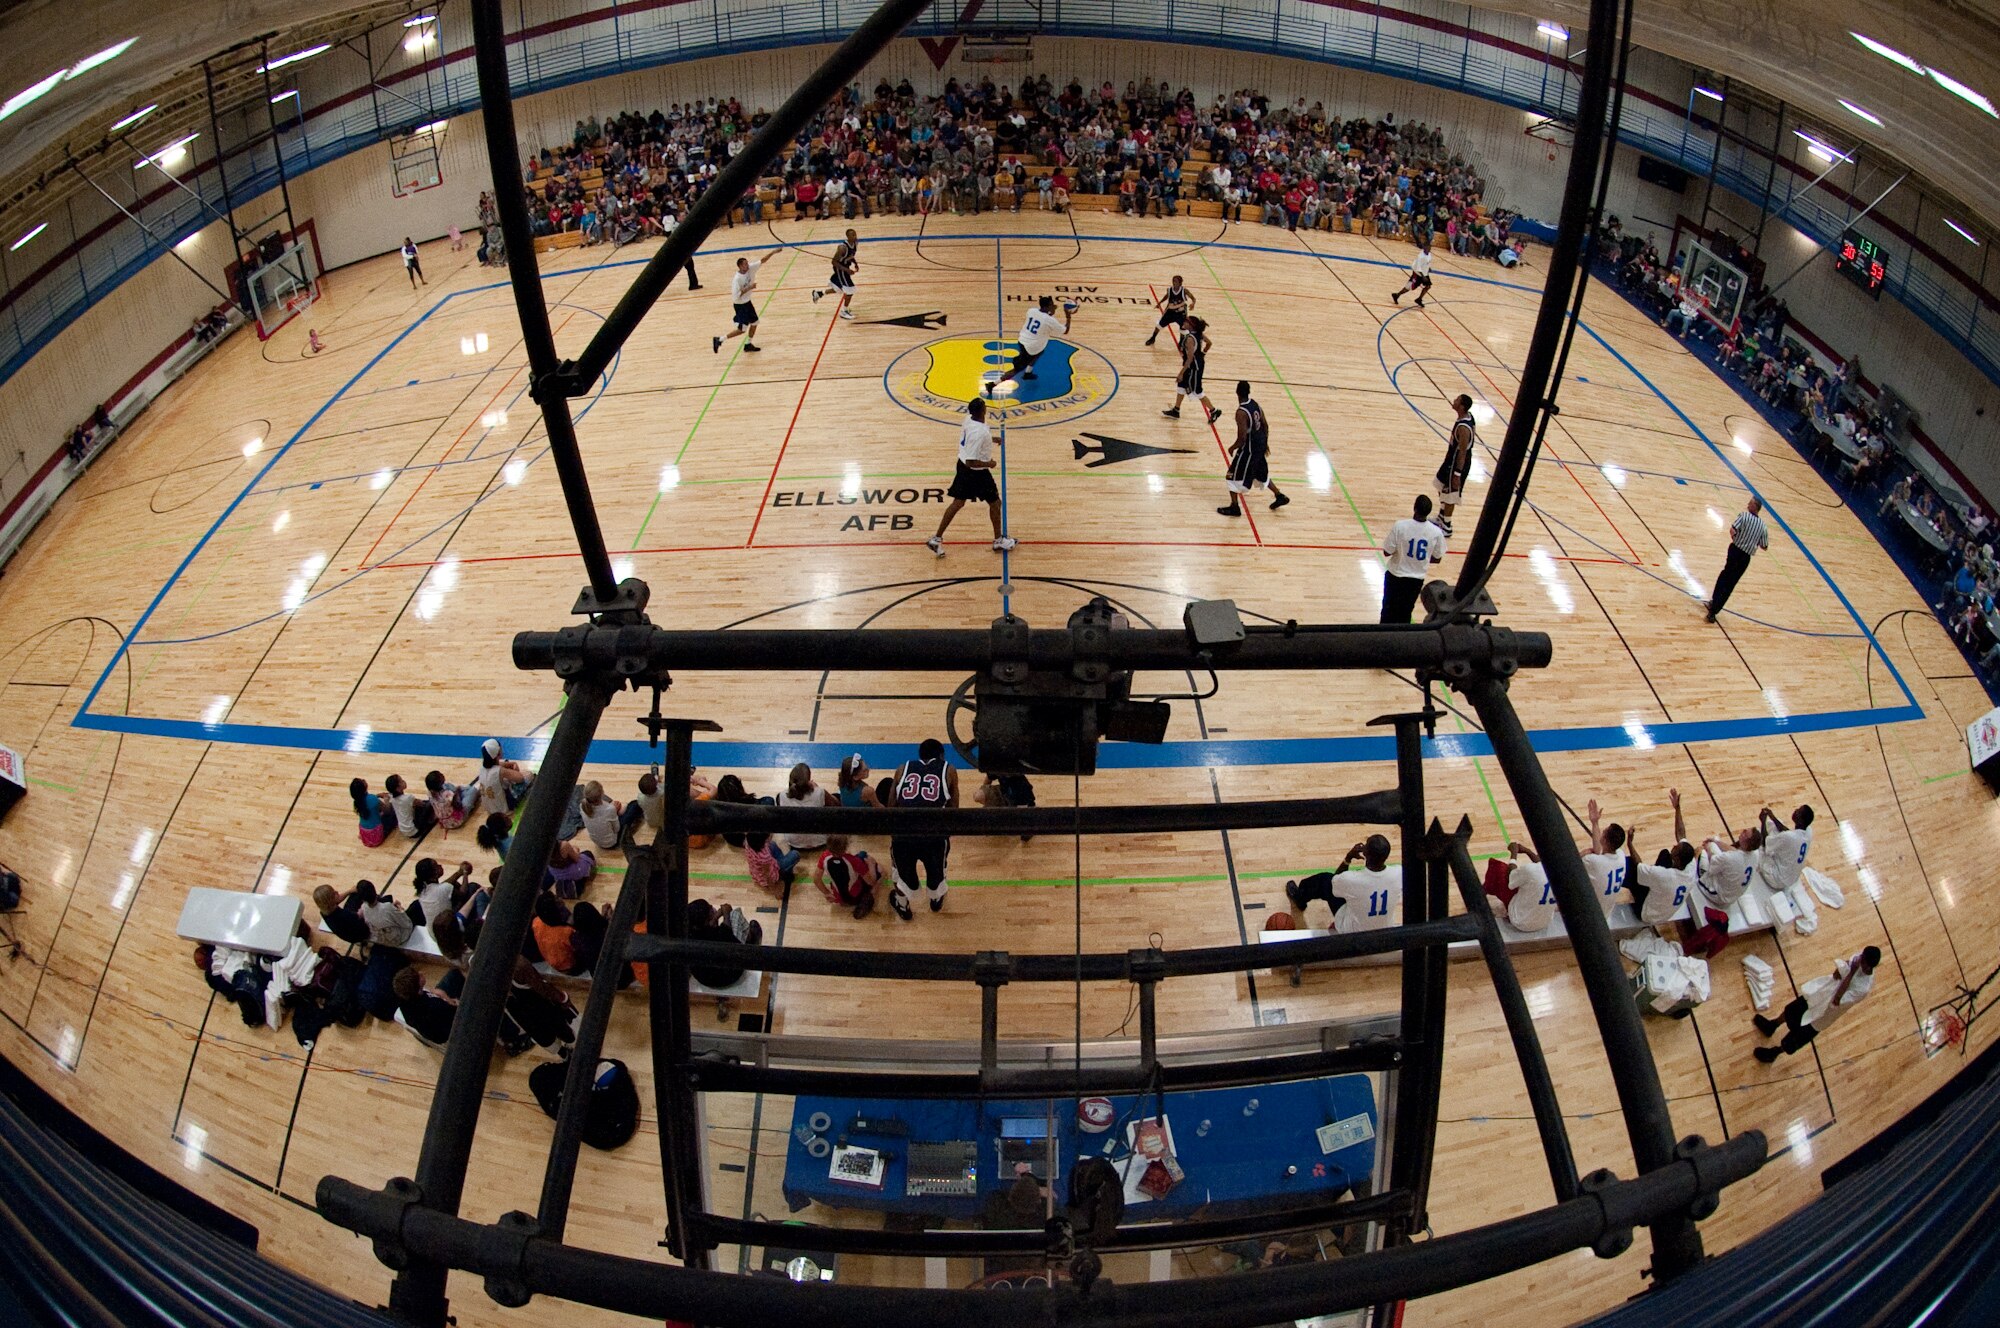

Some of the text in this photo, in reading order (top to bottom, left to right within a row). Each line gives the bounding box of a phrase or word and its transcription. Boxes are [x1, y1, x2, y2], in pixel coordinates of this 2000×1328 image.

[1870, 262, 1884, 280] 53
[1006, 294, 1152, 305] ELLSWOTH
[1054, 285, 1099, 293] AFB
[1026, 316, 1041, 335] 12
[955, 404, 1026, 421] BMB
[772, 487, 985, 508] ELLSWOR
[840, 514, 914, 531] AFB
[1406, 538, 1428, 561] 16
[902, 772, 940, 802] 33
[1797, 842, 1807, 864] 9
[1604, 867, 1624, 896] 15
[1741, 866, 1753, 887] 3
[1368, 889, 1389, 917] 11
[1538, 882, 1557, 904] 1
[1672, 885, 1687, 906] 6
